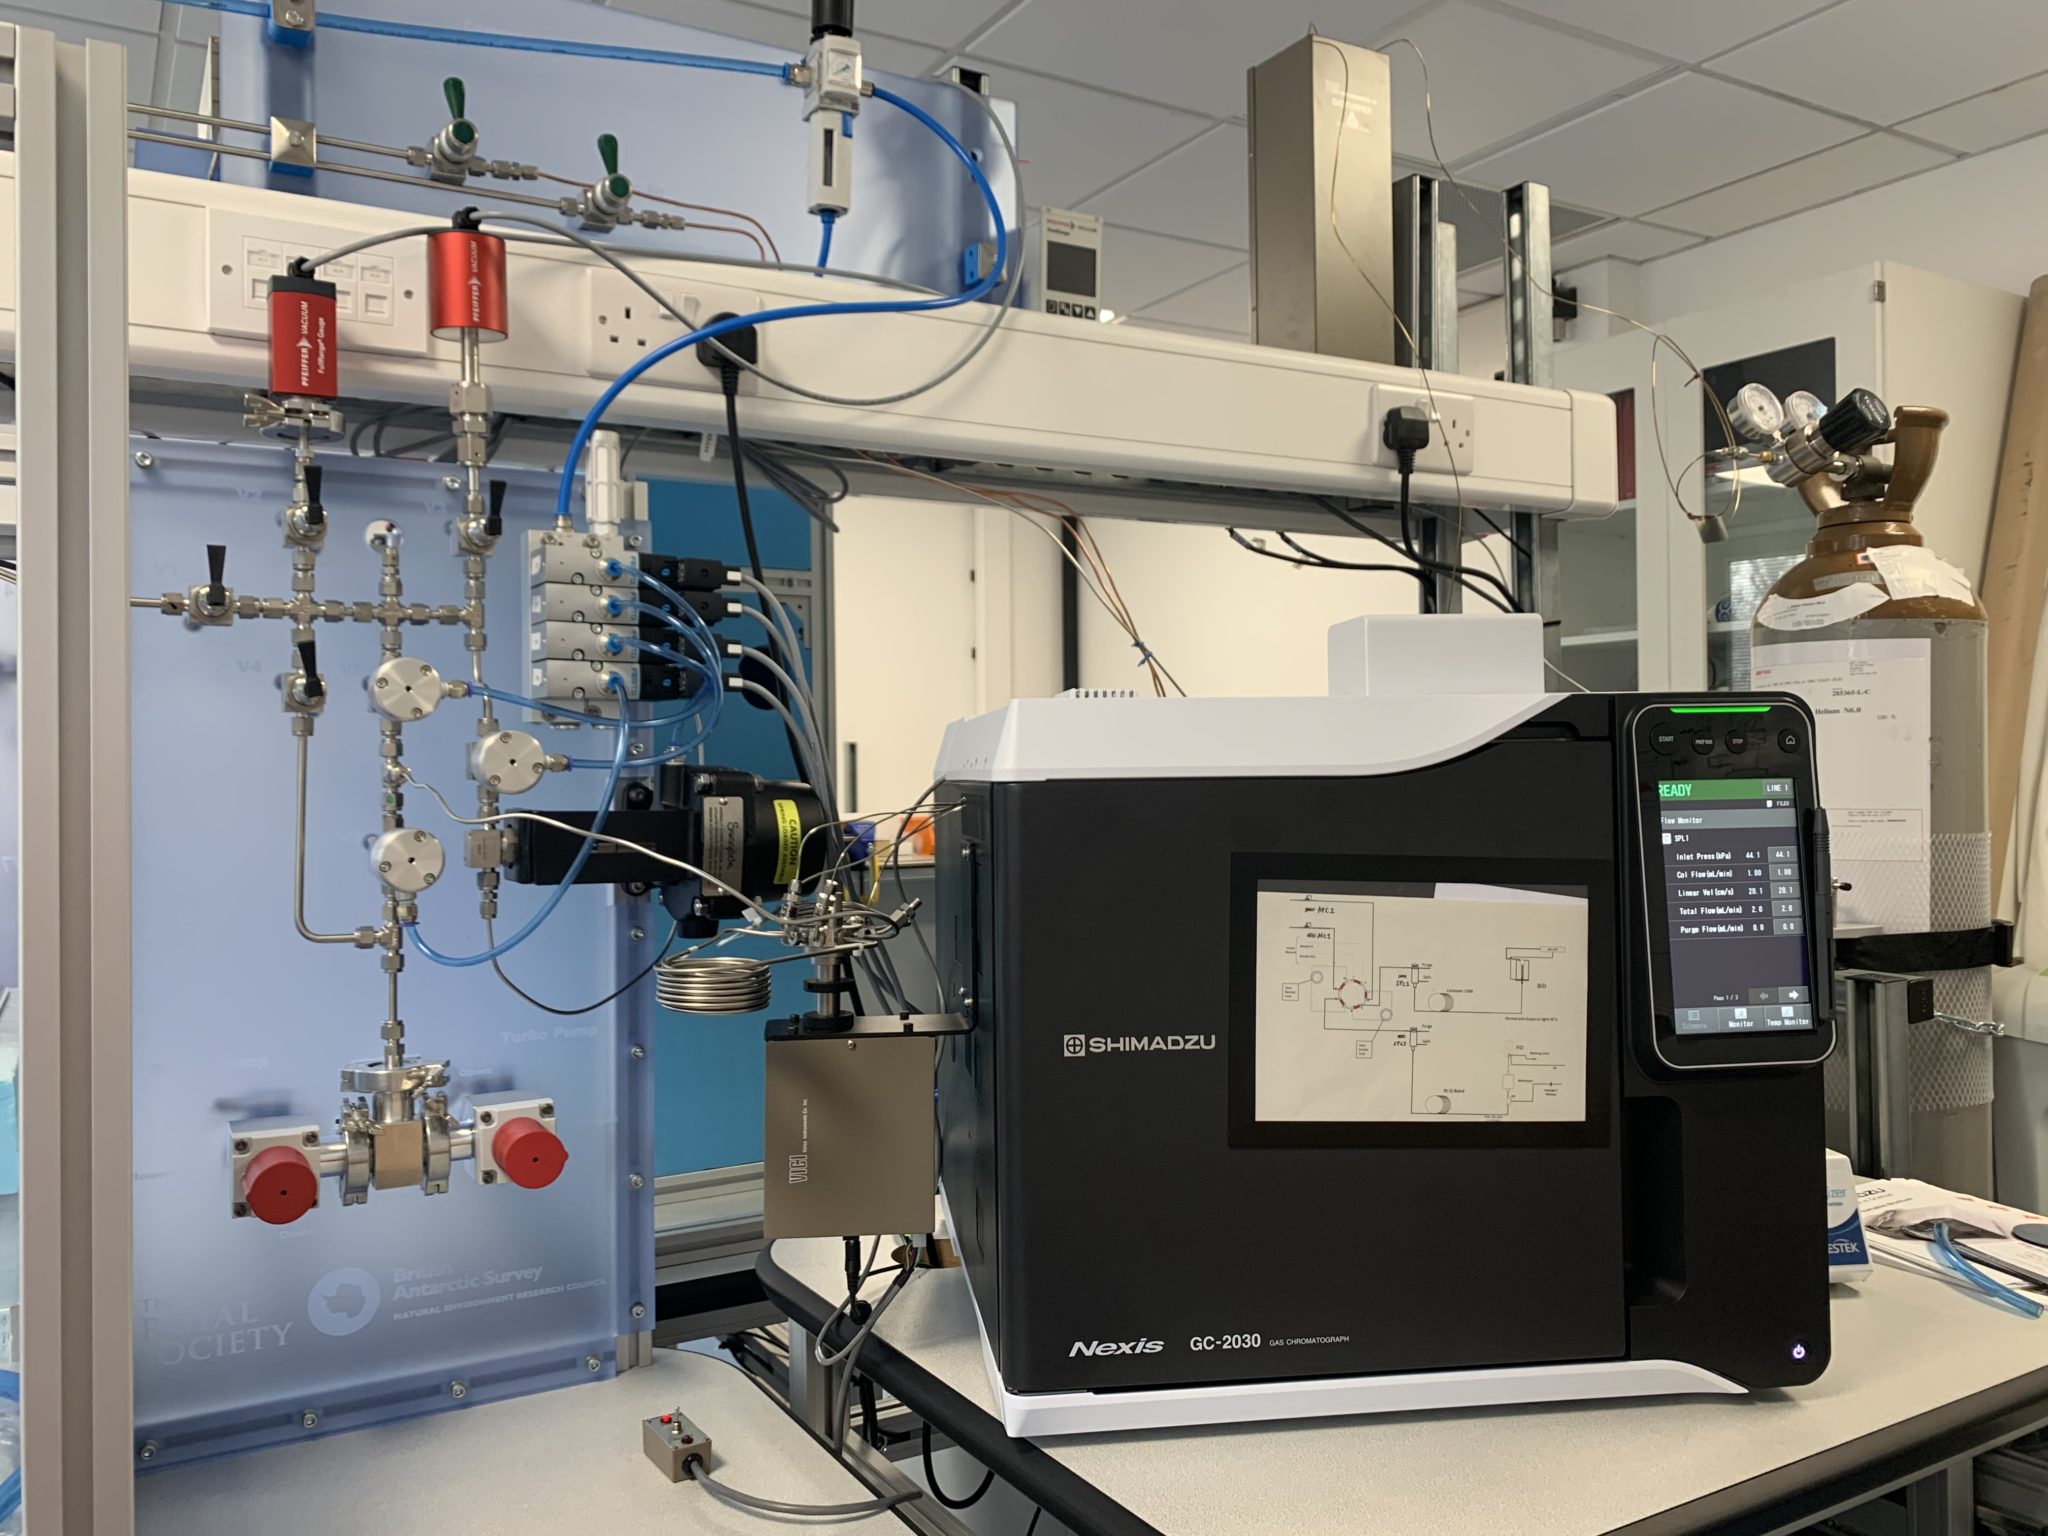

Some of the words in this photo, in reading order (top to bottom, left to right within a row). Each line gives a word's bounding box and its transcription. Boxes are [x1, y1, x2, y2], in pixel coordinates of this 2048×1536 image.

[470, 240, 478, 272] VACUUM
[472, 285, 480, 322] PFEIFFER
[301, 300, 309, 335] VACUUM
[301, 348, 310, 387] PFEIFFER
[1815, 707, 1840, 716] Helium
[1659, 784, 1692, 797] READY
[1661, 817, 1675, 825] Flow
[1677, 817, 1703, 825] Monitor
[789, 818, 798, 866] CAUTION
[1674, 834, 1690, 843] SPL1
[1676, 853, 1694, 861] Inlet
[1745, 851, 1761, 859] 44.1
[1775, 850, 1790, 858] 44.1
[1676, 871, 1688, 879] Col
[1747, 869, 1762, 877] 1.00
[1777, 868, 1792, 876] 1.00
[1678, 889, 1700, 897] Linear
[1748, 887, 1763, 895] 20.1
[1778, 886, 1793, 894] 20.1
[1679, 907, 1698, 916] Total
[1680, 926, 1700, 934] Purge
[1728, 1020, 1754, 1028] Monitor
[1766, 1019, 1782, 1027] Temp
[1784, 1018, 1810, 1026] Monitor
[500, 1029, 548, 1044] Turbo
[553, 1026, 599, 1041] Pump
[1088, 1034, 1217, 1053] SHIMADZU
[789, 1154, 808, 1184] VICI
[393, 1261, 454, 1284] British
[393, 1274, 481, 1300] Antarctic
[483, 1266, 544, 1287] Survey
[393, 1306, 441, 1321] NATURAL
[444, 1293, 515, 1312] ENVIRONMENT
[516, 1285, 565, 1300] RESEARCH
[566, 1277, 608, 1291] COUNCIL
[1068, 1337, 1165, 1358] Nexis
[1189, 1333, 1262, 1352] GC-2030
[1269, 1338, 1285, 1347] GAS
[1286, 1335, 1350, 1346] CHROMATOGRAPH
